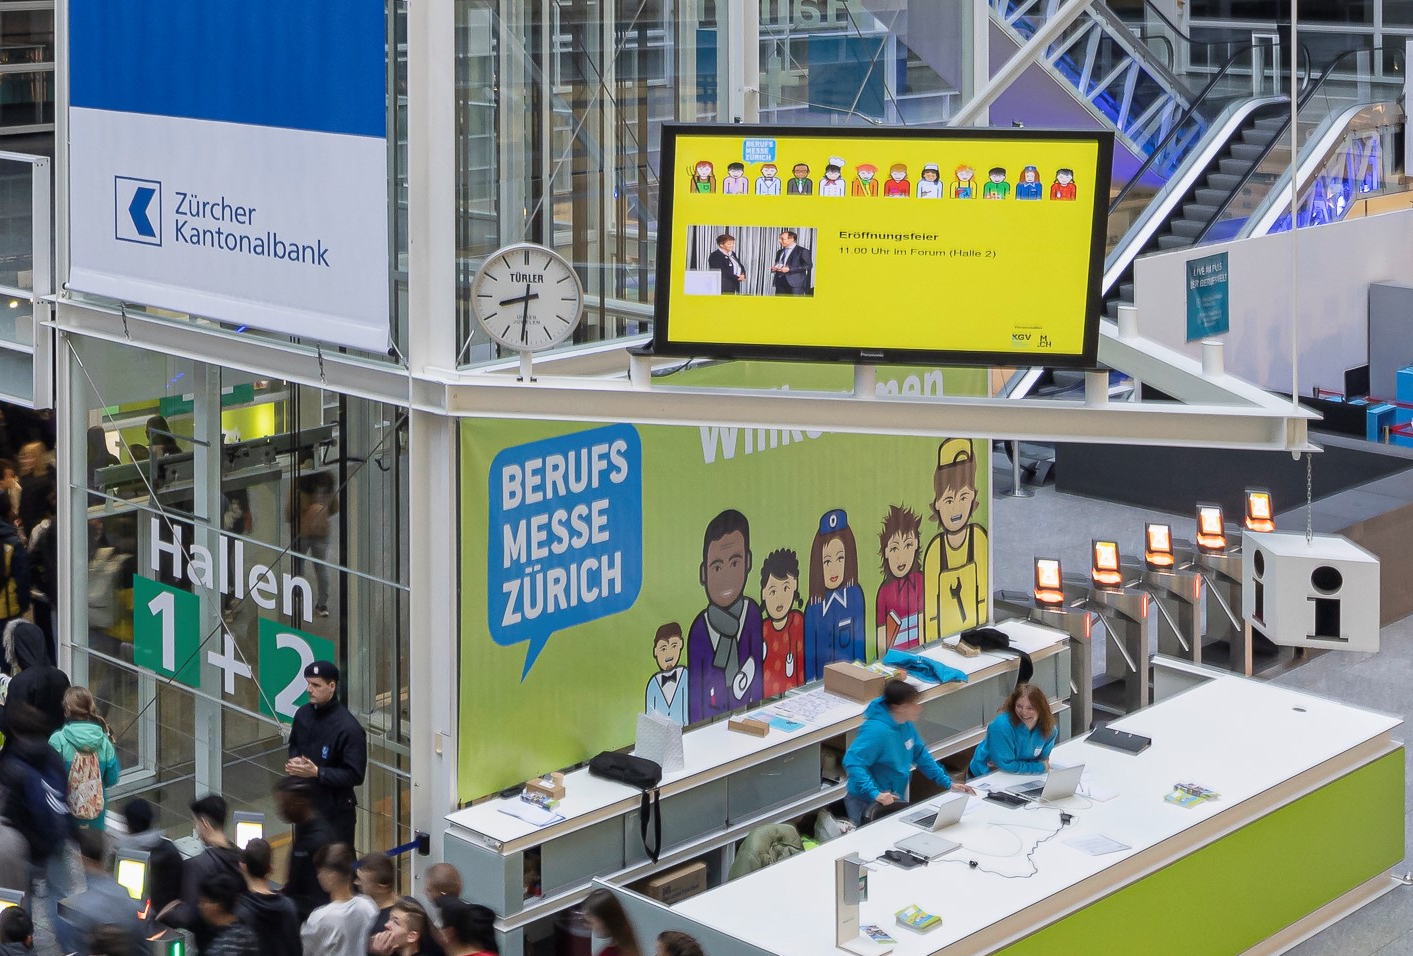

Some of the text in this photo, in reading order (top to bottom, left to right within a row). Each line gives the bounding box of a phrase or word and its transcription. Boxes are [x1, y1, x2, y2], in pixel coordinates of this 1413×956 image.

[174, 191, 257, 226] Zürcher
[839, 231, 939, 242] Eröffnungsfeier
[174, 218, 331, 268] Kantonalbank
[839, 247, 868, 255] 11.00
[871, 247, 890, 256] Uhr
[910, 248, 946, 257] Forum
[949, 249, 982, 258] (Halle
[985, 250, 997, 259] 2)
[510, 272, 544, 284] TÜRLER
[502, 440, 629, 511] BERUFS
[503, 498, 610, 569] MESSE
[150, 517, 313, 624] Hallen
[501, 551, 622, 627] ZÜRICH
[147, 591, 175, 672] 1
[274, 633, 315, 718] 2
